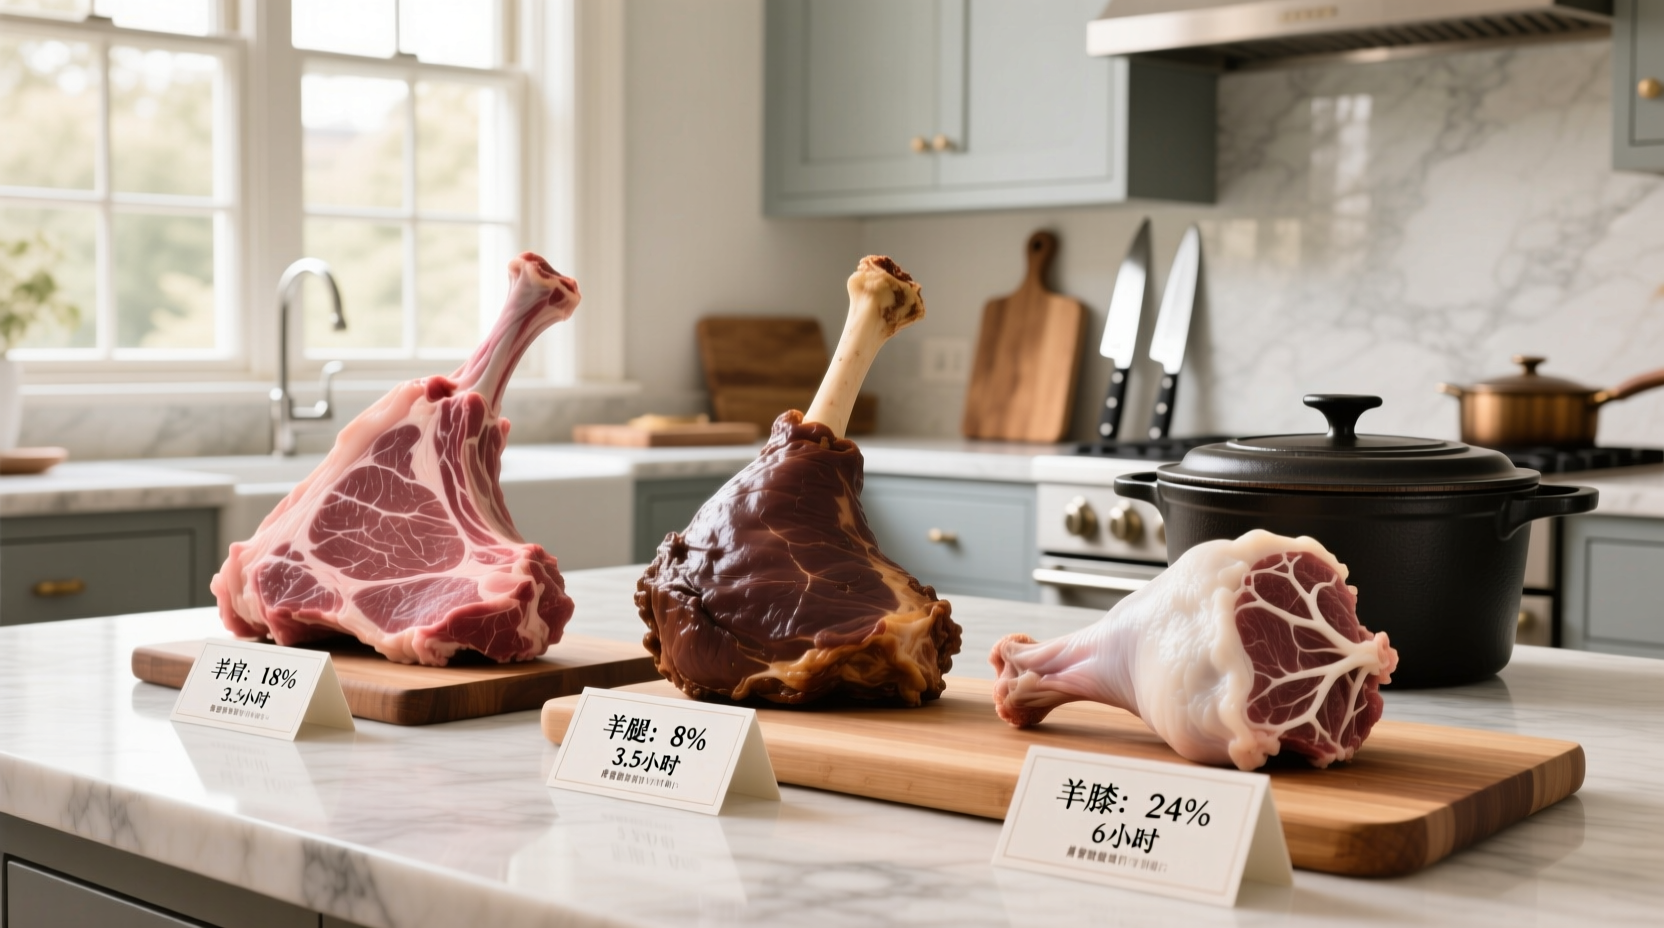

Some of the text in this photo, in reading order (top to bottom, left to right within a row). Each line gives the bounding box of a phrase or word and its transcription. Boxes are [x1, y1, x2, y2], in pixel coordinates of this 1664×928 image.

[261, 667, 298, 689] 18%
[603, 713, 707, 751] 羊腿： 8%
[611, 747, 681, 776] 3.5小时
[1056, 777, 1211, 827] 羊膝： 24%
[1091, 822, 1160, 854] 6小时
